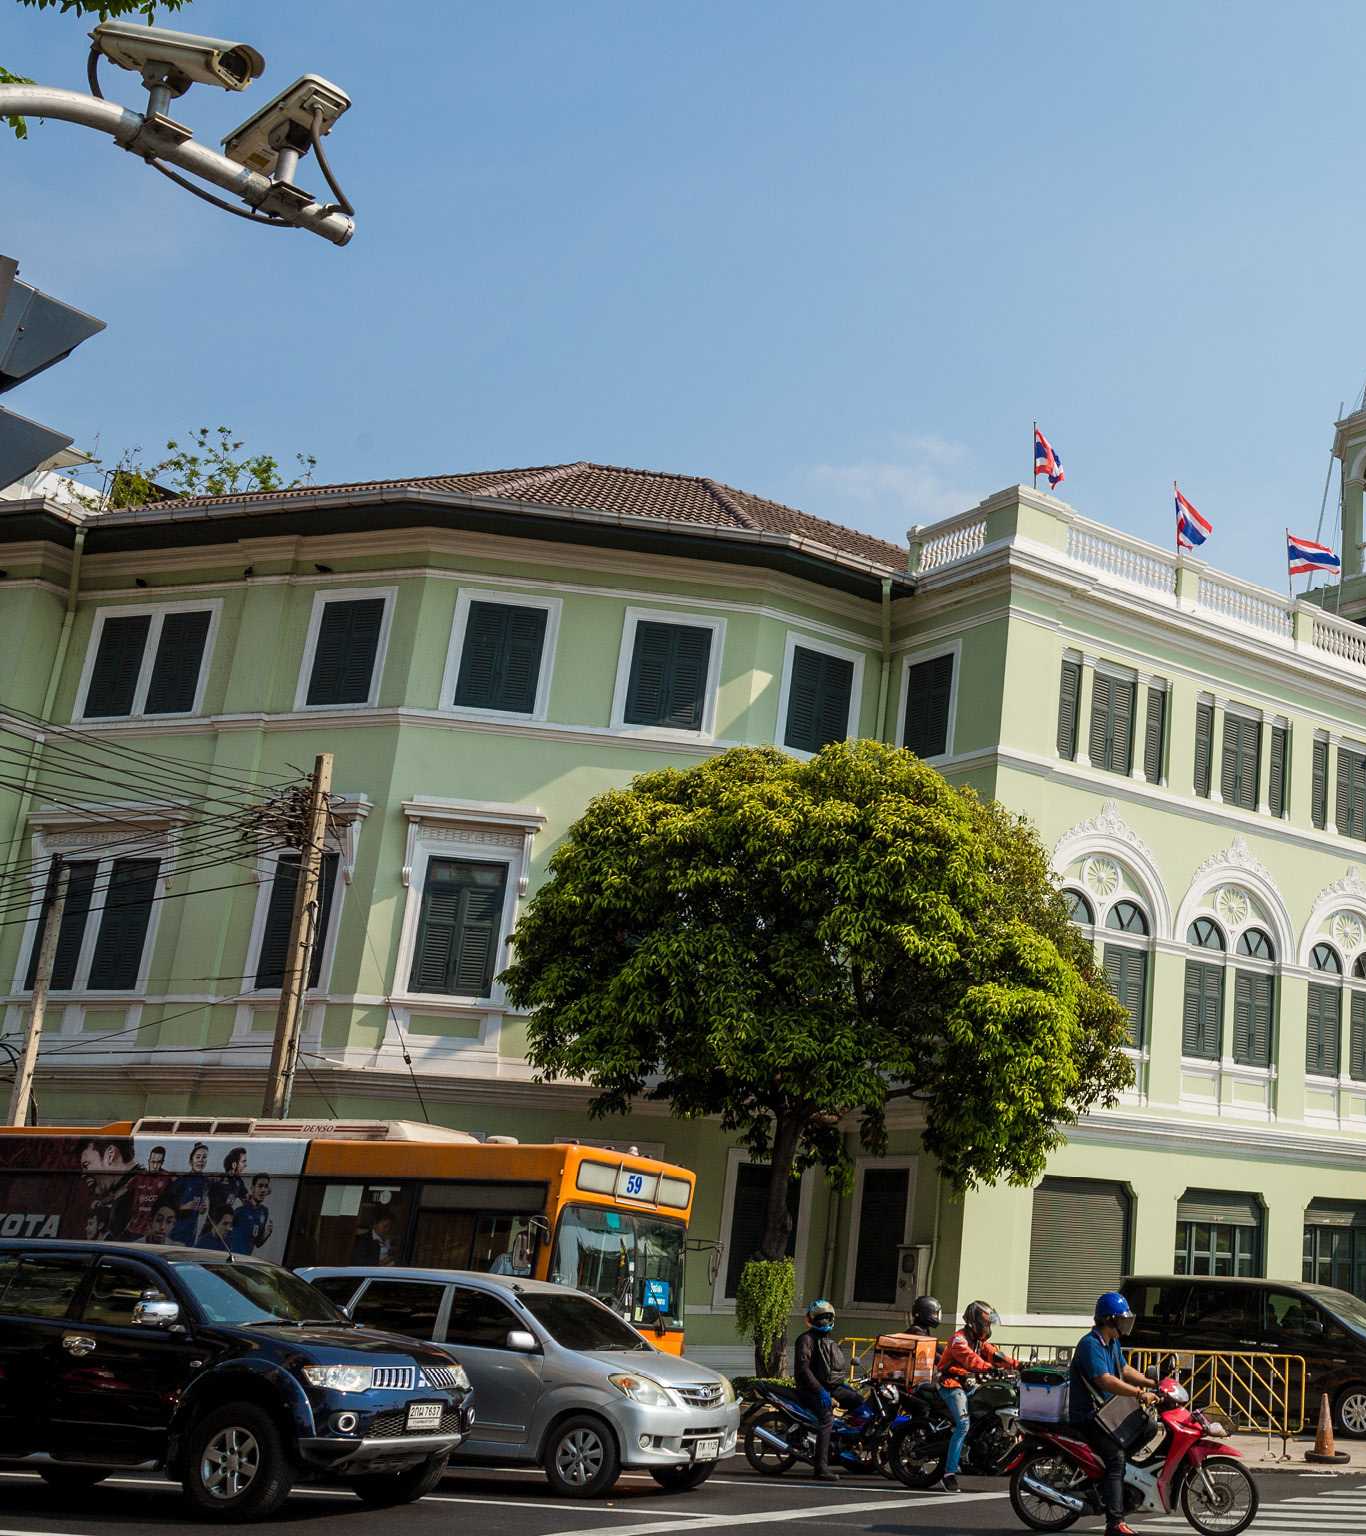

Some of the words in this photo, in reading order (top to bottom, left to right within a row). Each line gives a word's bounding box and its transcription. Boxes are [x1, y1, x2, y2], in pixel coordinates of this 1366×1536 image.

[303, 1125, 334, 1133] DENSO
[626, 1175, 643, 1194] 59
[425, 1406, 441, 1416] 7637
